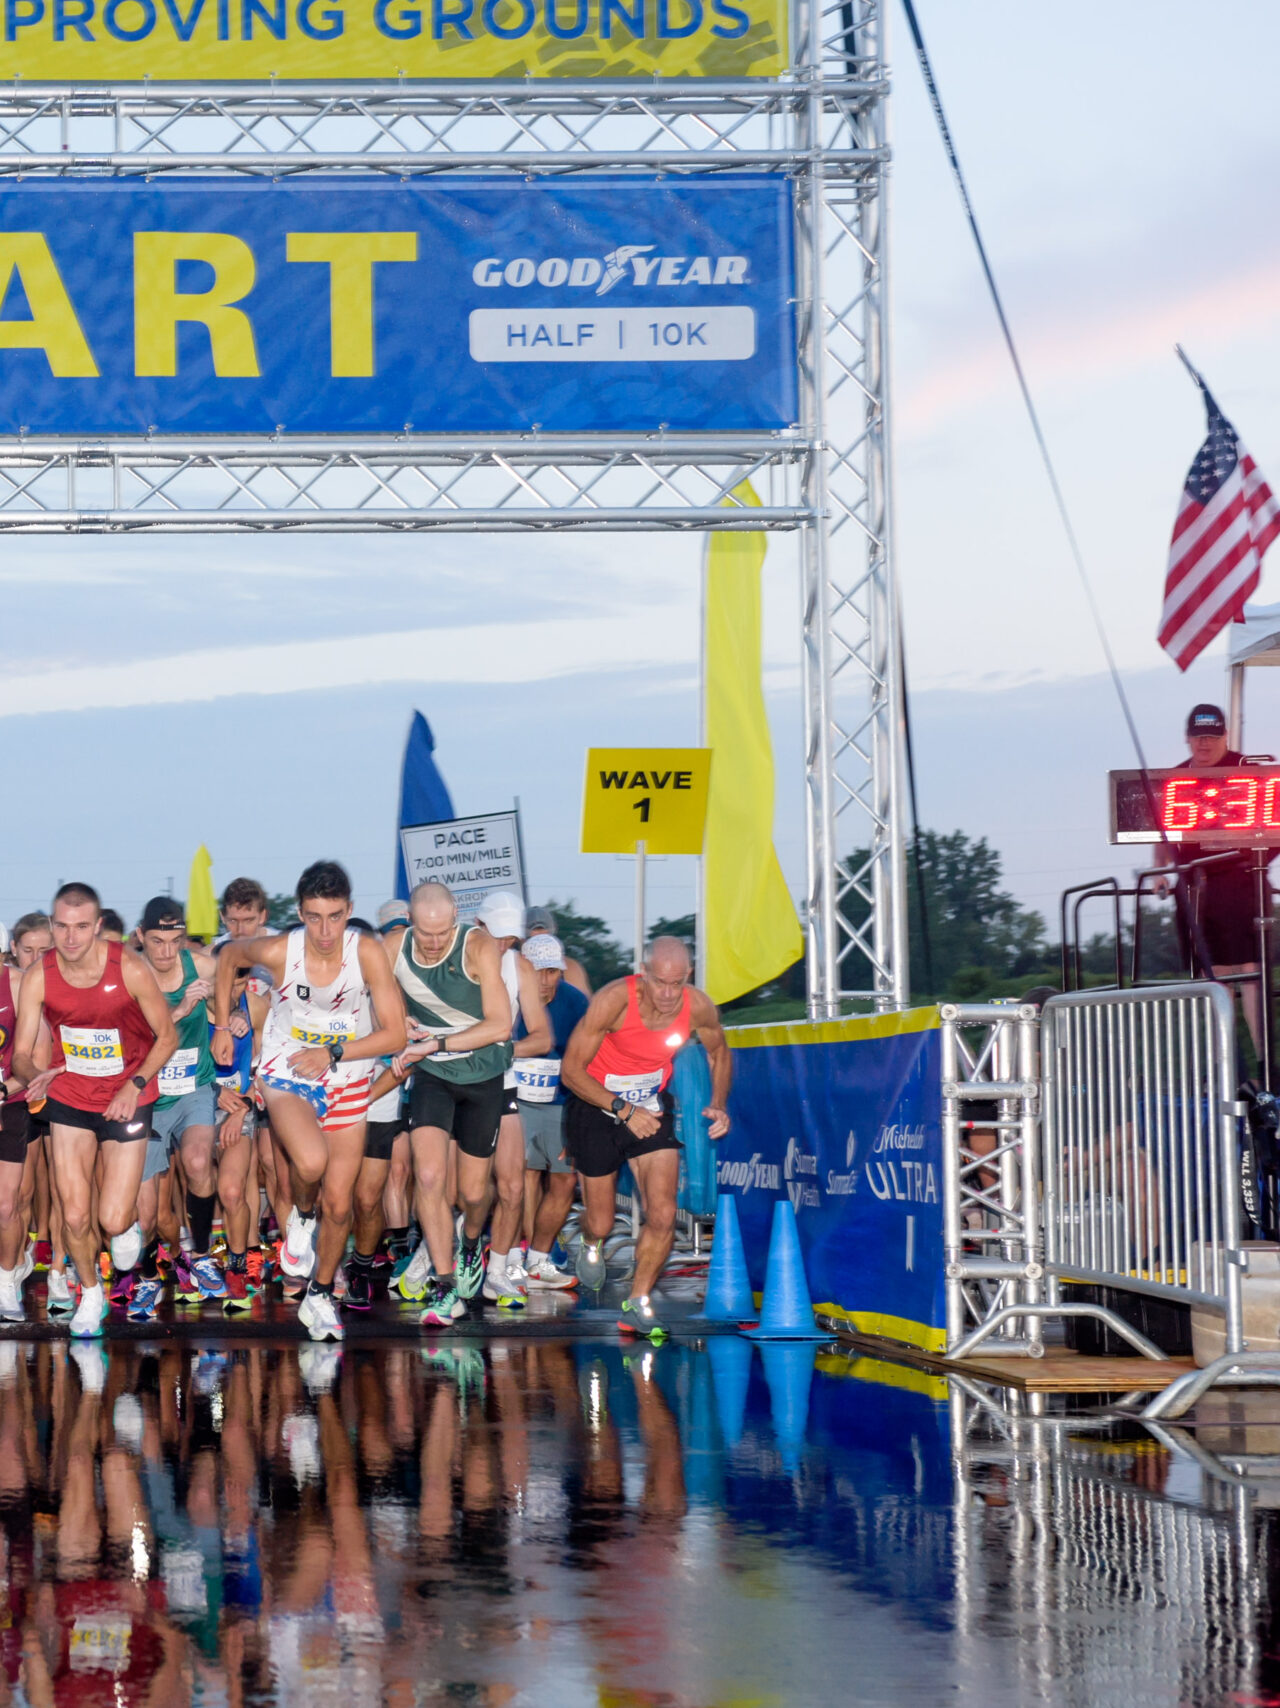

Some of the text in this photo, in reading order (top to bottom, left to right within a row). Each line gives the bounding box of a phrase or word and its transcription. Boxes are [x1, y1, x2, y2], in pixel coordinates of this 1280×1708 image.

[4, 0, 345, 42] PROVING
[372, 0, 751, 41] GROUNDS
[472, 244, 752, 297] GOODYEAR
[506, 321, 707, 347] HALF 10K
[599, 770, 693, 790] WAVE
[632, 797, 651, 823] 1
[433, 827, 488, 849] PACE
[413, 846, 513, 870] 7:00 MIN/MILE
[441, 865, 513, 885] WALKERS
[455, 891, 489, 904] KRON
[329, 1022, 347, 1031] 10k
[93, 1034, 112, 1043] 10k
[68, 1043, 116, 1059] 3482
[520, 1073, 549, 1087] 311
[864, 1161, 937, 1204] ULTRA
